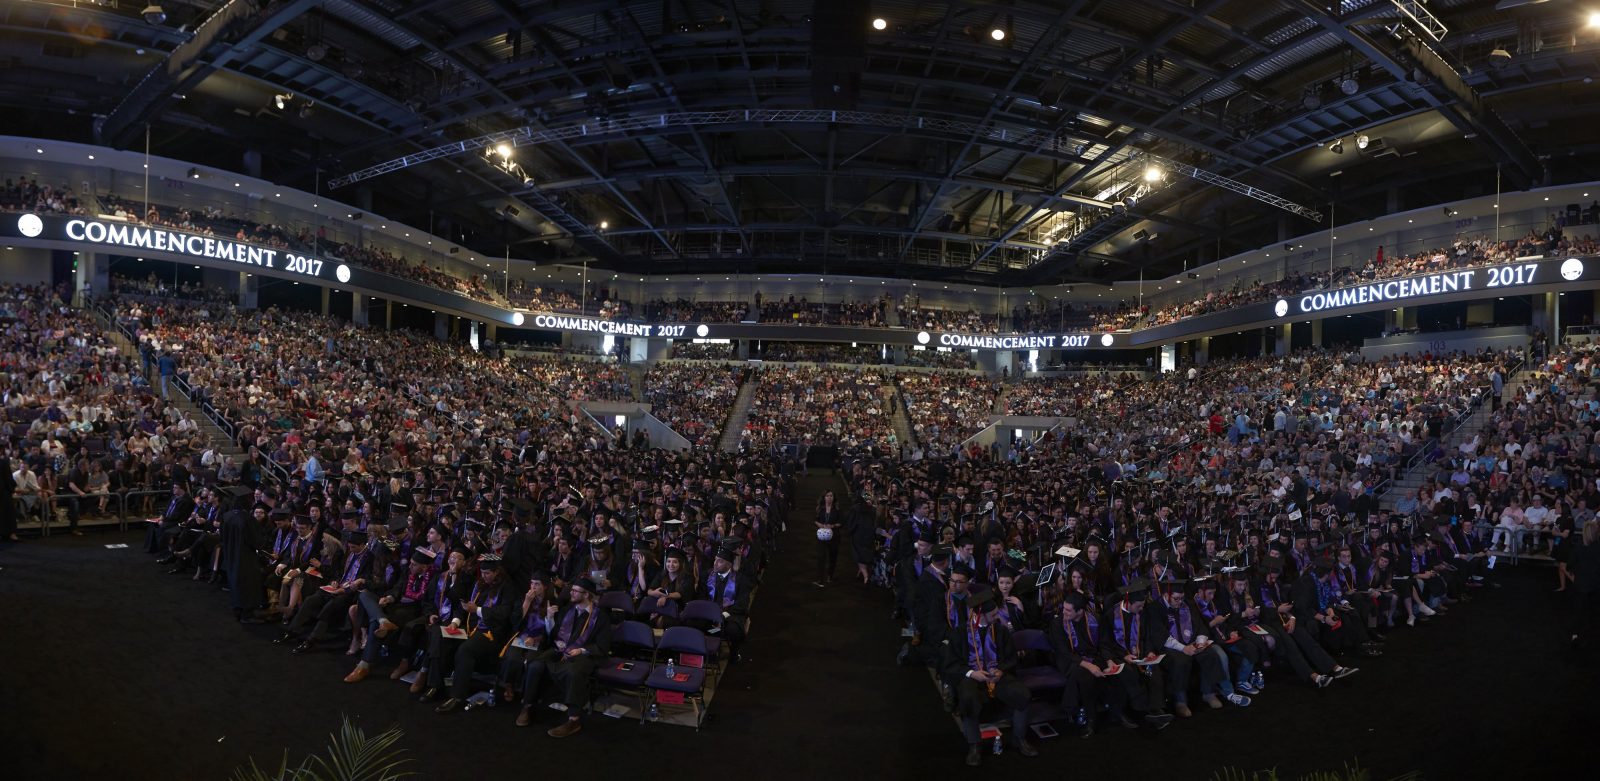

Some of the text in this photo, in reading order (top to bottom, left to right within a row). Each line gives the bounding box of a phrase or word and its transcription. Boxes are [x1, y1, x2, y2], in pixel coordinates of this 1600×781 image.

[65, 219, 323, 276] COMMENCEMENT 2017
[1300, 263, 1538, 312] COMMENCEMENT 2017
[535, 315, 686, 337] COMMENCEMENT 2017
[940, 334, 1090, 349] COMMENCEMENT 2017
[1429, 340, 1446, 351] 103
